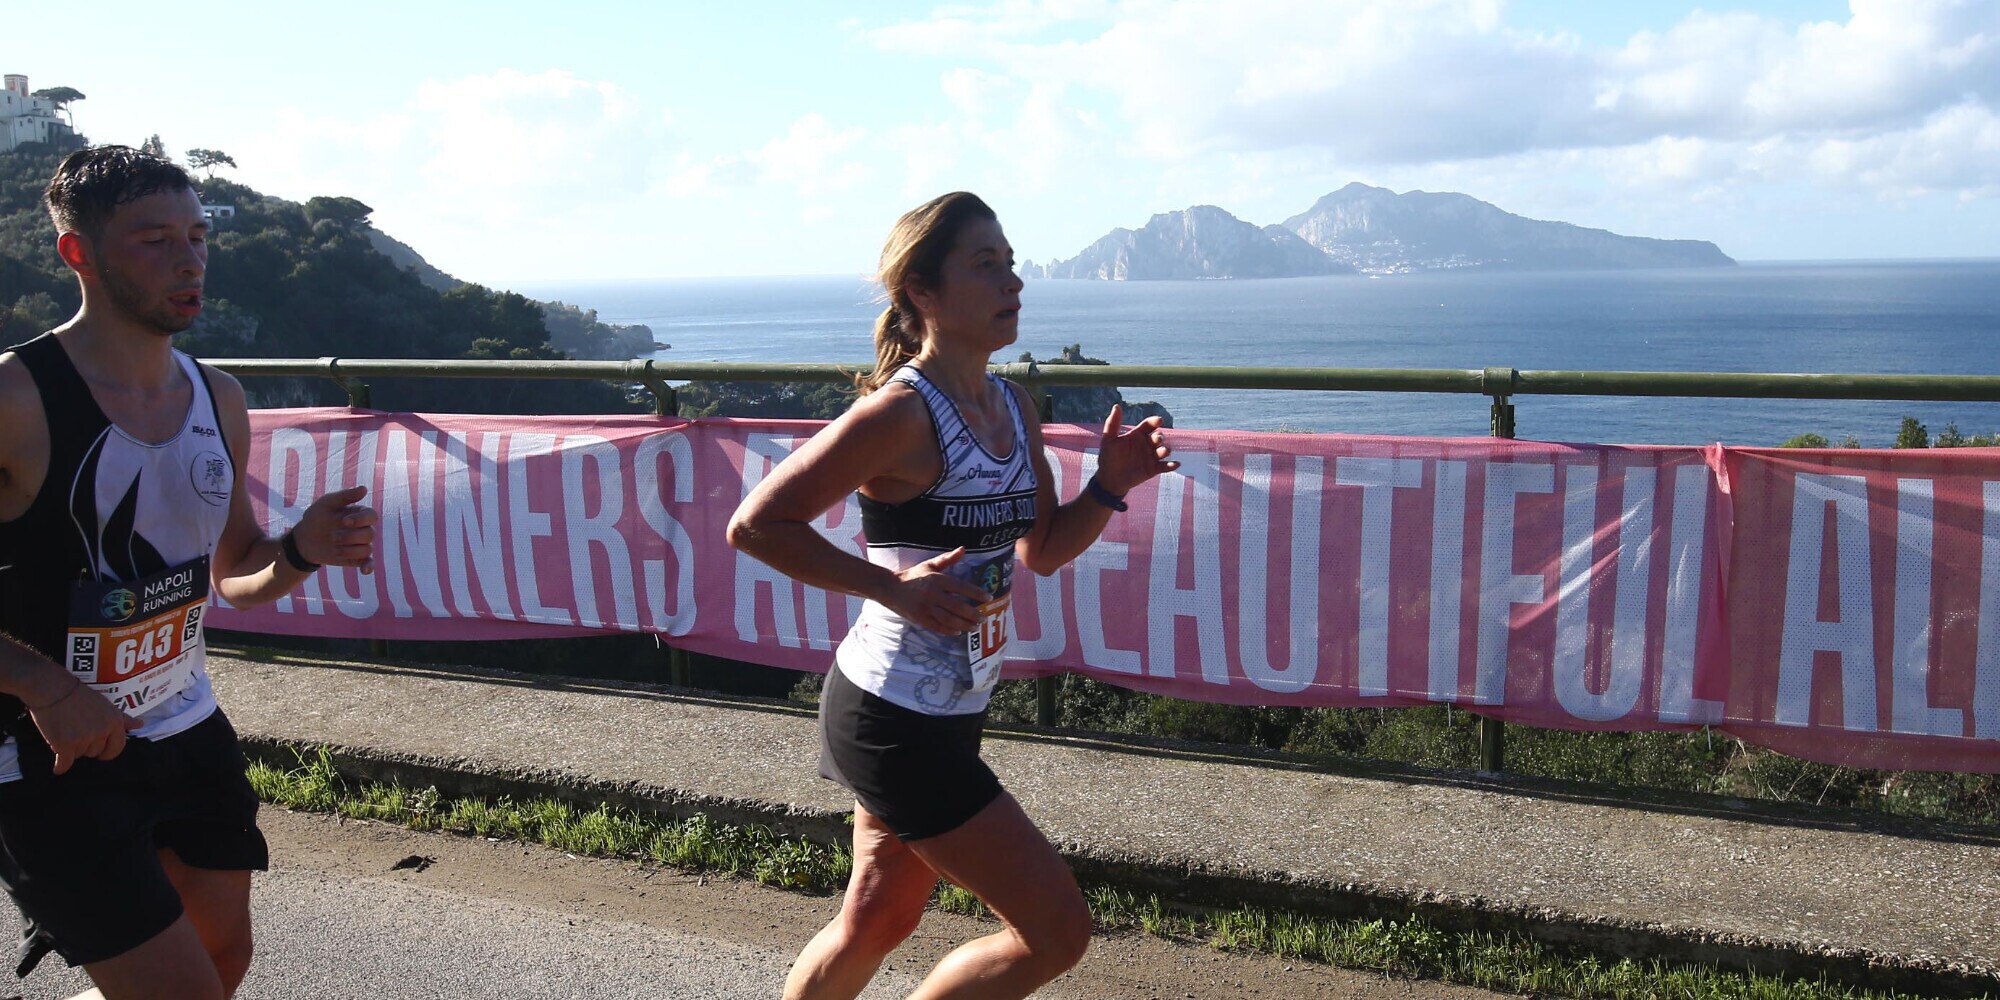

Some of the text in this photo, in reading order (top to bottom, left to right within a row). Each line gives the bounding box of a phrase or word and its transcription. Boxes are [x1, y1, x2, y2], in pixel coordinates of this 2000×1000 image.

[942, 501, 1014, 528] RUNNERS
[144, 569, 193, 598] NAPOLI
[268, 428, 697, 637] RUNNERS
[734, 433, 867, 650] AR
[1775, 473, 2000, 740] AL
[143, 586, 192, 613] RUNNING
[115, 623, 174, 675] 643
